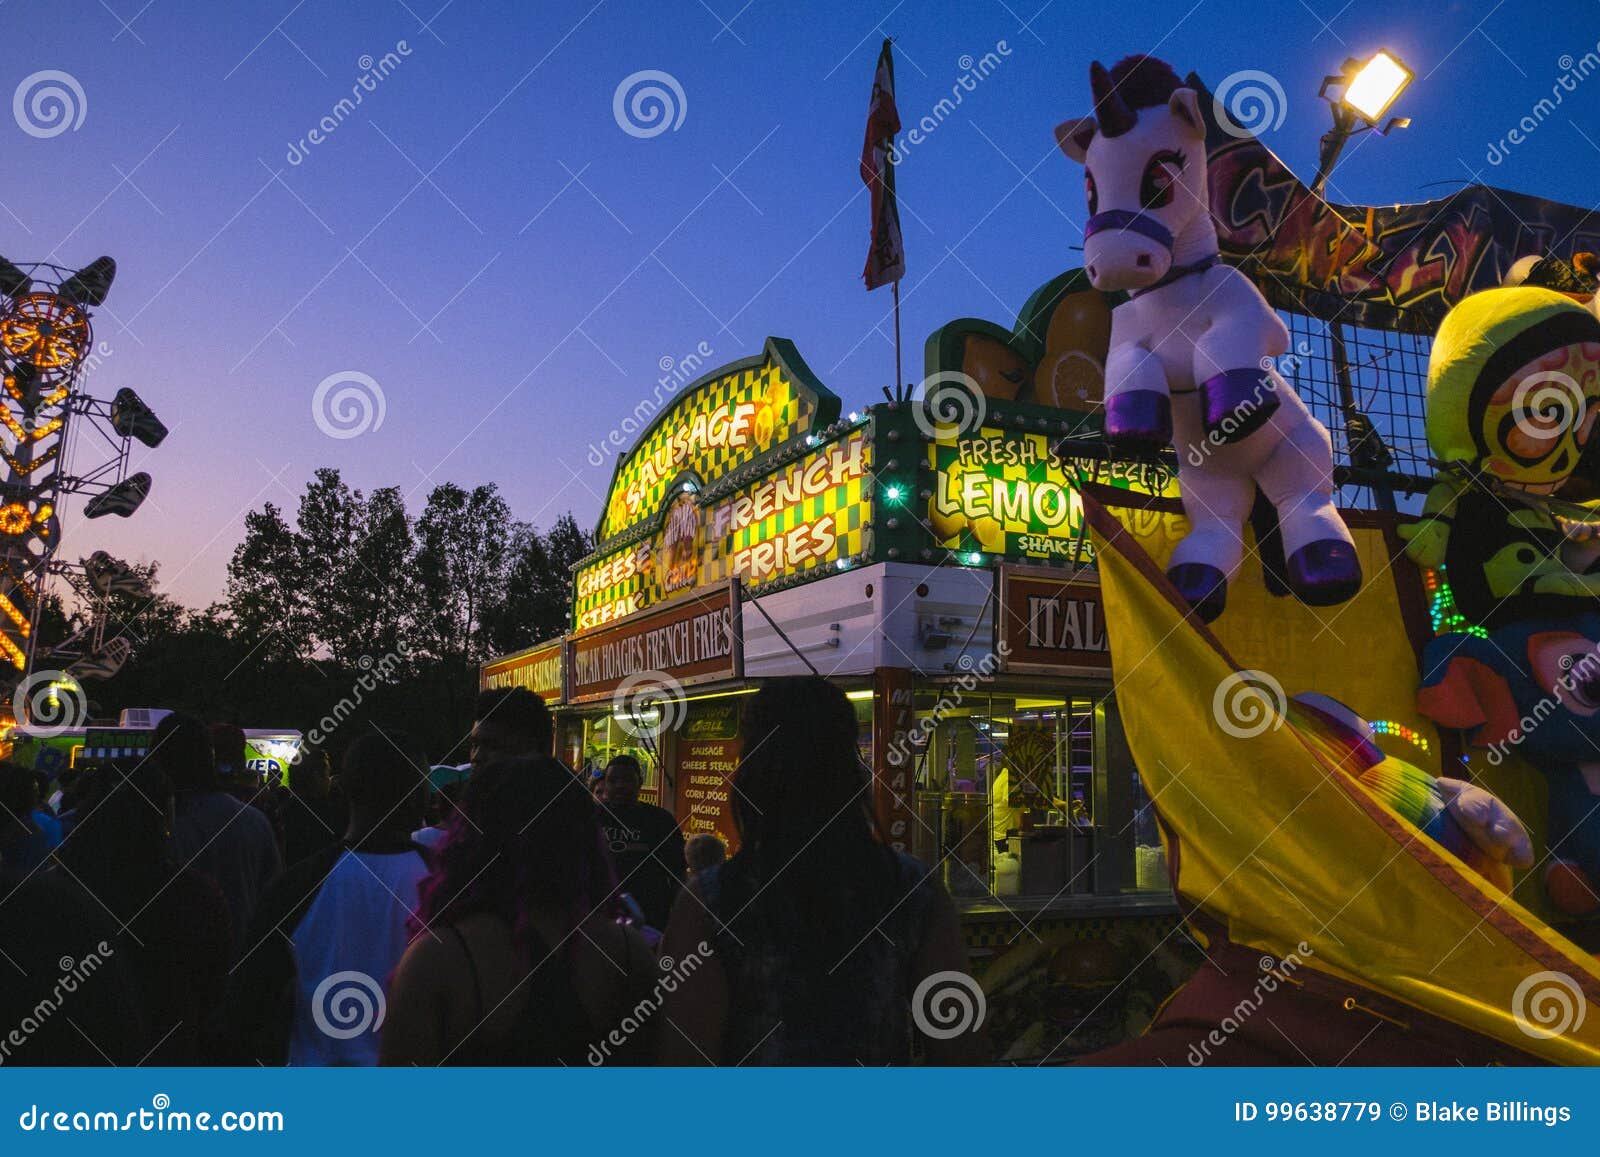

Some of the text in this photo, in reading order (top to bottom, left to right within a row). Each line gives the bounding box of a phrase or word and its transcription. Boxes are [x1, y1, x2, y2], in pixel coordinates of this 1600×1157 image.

[624, 402, 755, 515] SAUSAGE
[958, 438, 1036, 467] FRESH
[713, 439, 865, 538] FRENCH
[733, 515, 835, 577] FRIES
[577, 545, 650, 598] CHEESE
[579, 591, 644, 630] STEAK
[1028, 597, 1110, 651] ITAL
[575, 607, 732, 686] STEAK HOAGIES FRENCH FRIES
[681, 760, 734, 771] CHEESE STEAK
[691, 746, 724, 756] SAUSAGE
[685, 789, 728, 802] CORN DOGS
[690, 775, 724, 786] BURGERS
[690, 804, 721, 816] NACHOS
[695, 819, 715, 831] FRIES
